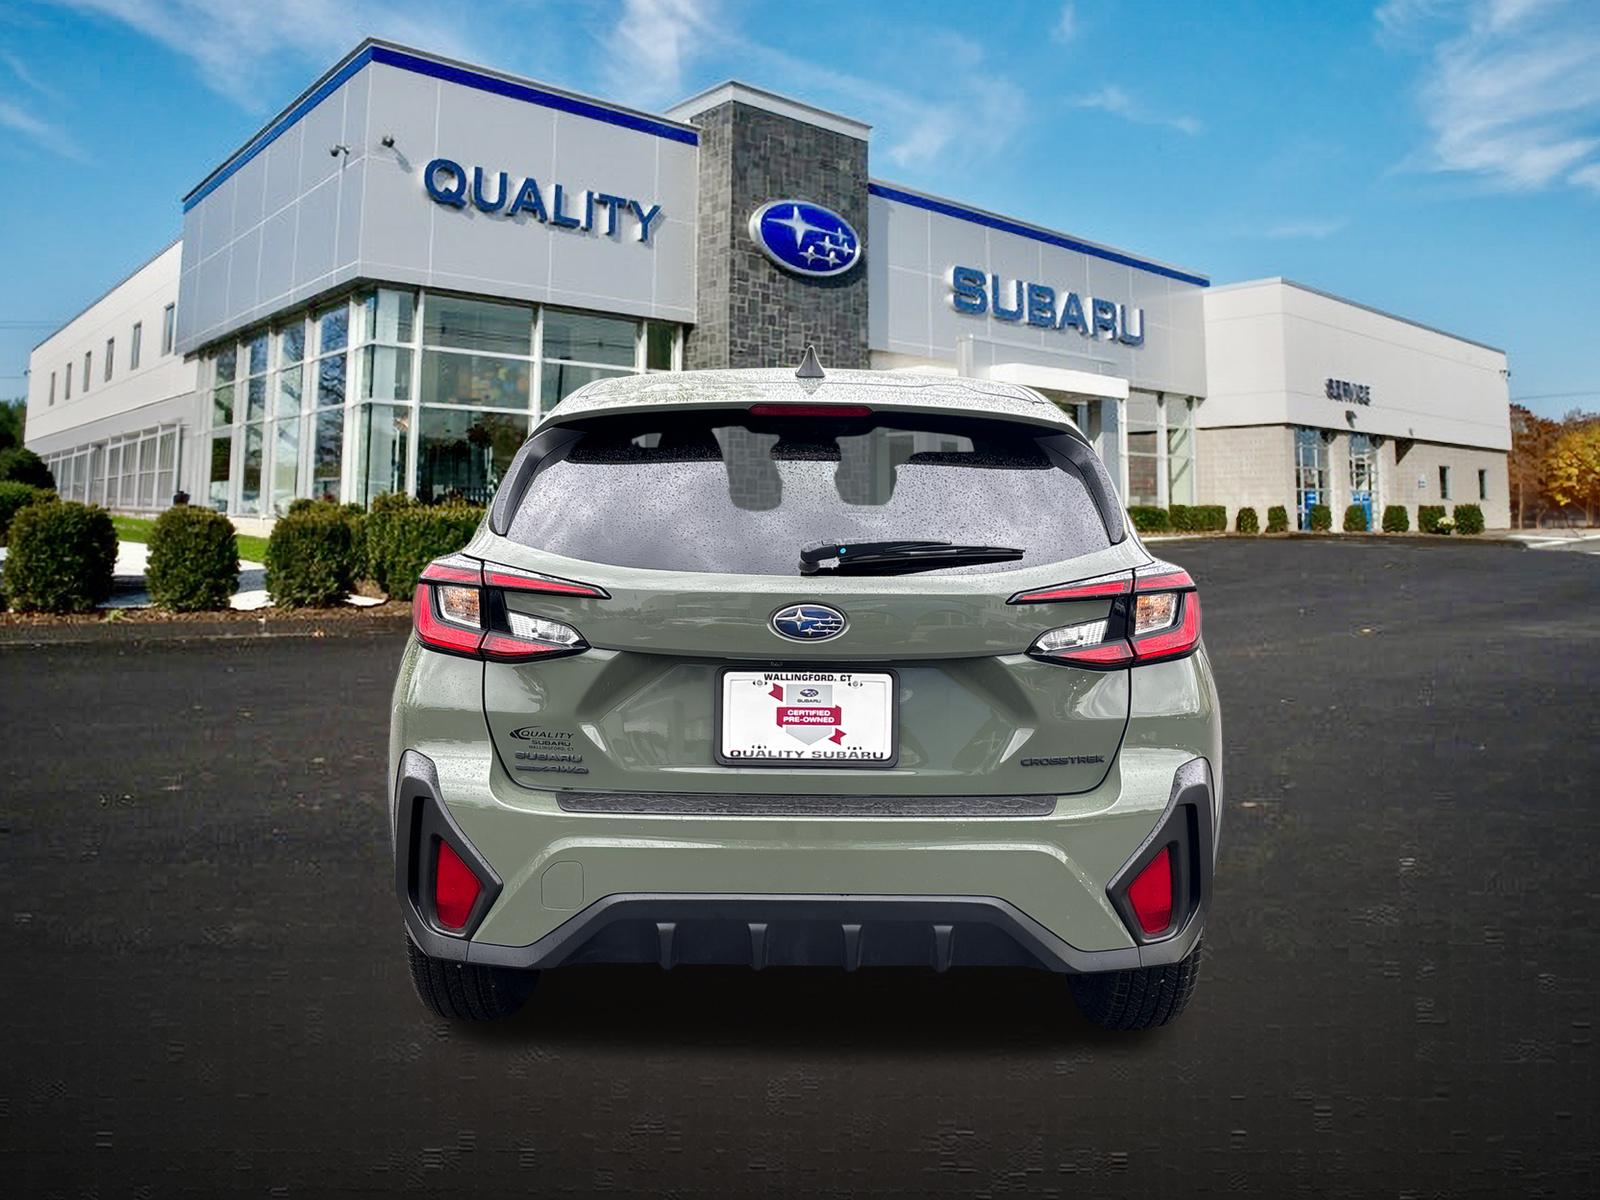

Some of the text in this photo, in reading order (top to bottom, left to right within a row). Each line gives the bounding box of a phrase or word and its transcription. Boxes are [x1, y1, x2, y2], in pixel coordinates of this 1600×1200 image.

[423, 157, 661, 243] QUALITY
[951, 265, 1145, 346] SUBARU
[1325, 378, 1371, 406] SERVICE
[840, 674, 852, 682] CT
[787, 709, 831, 717] CERTIFIED
[783, 716, 835, 724] PRE-OWNED
[521, 730, 574, 738] QUALITY
[515, 752, 583, 763] SUBARU
[730, 749, 884, 759] QUALITY SUBARU
[1020, 755, 1105, 767] CROSSTREK
